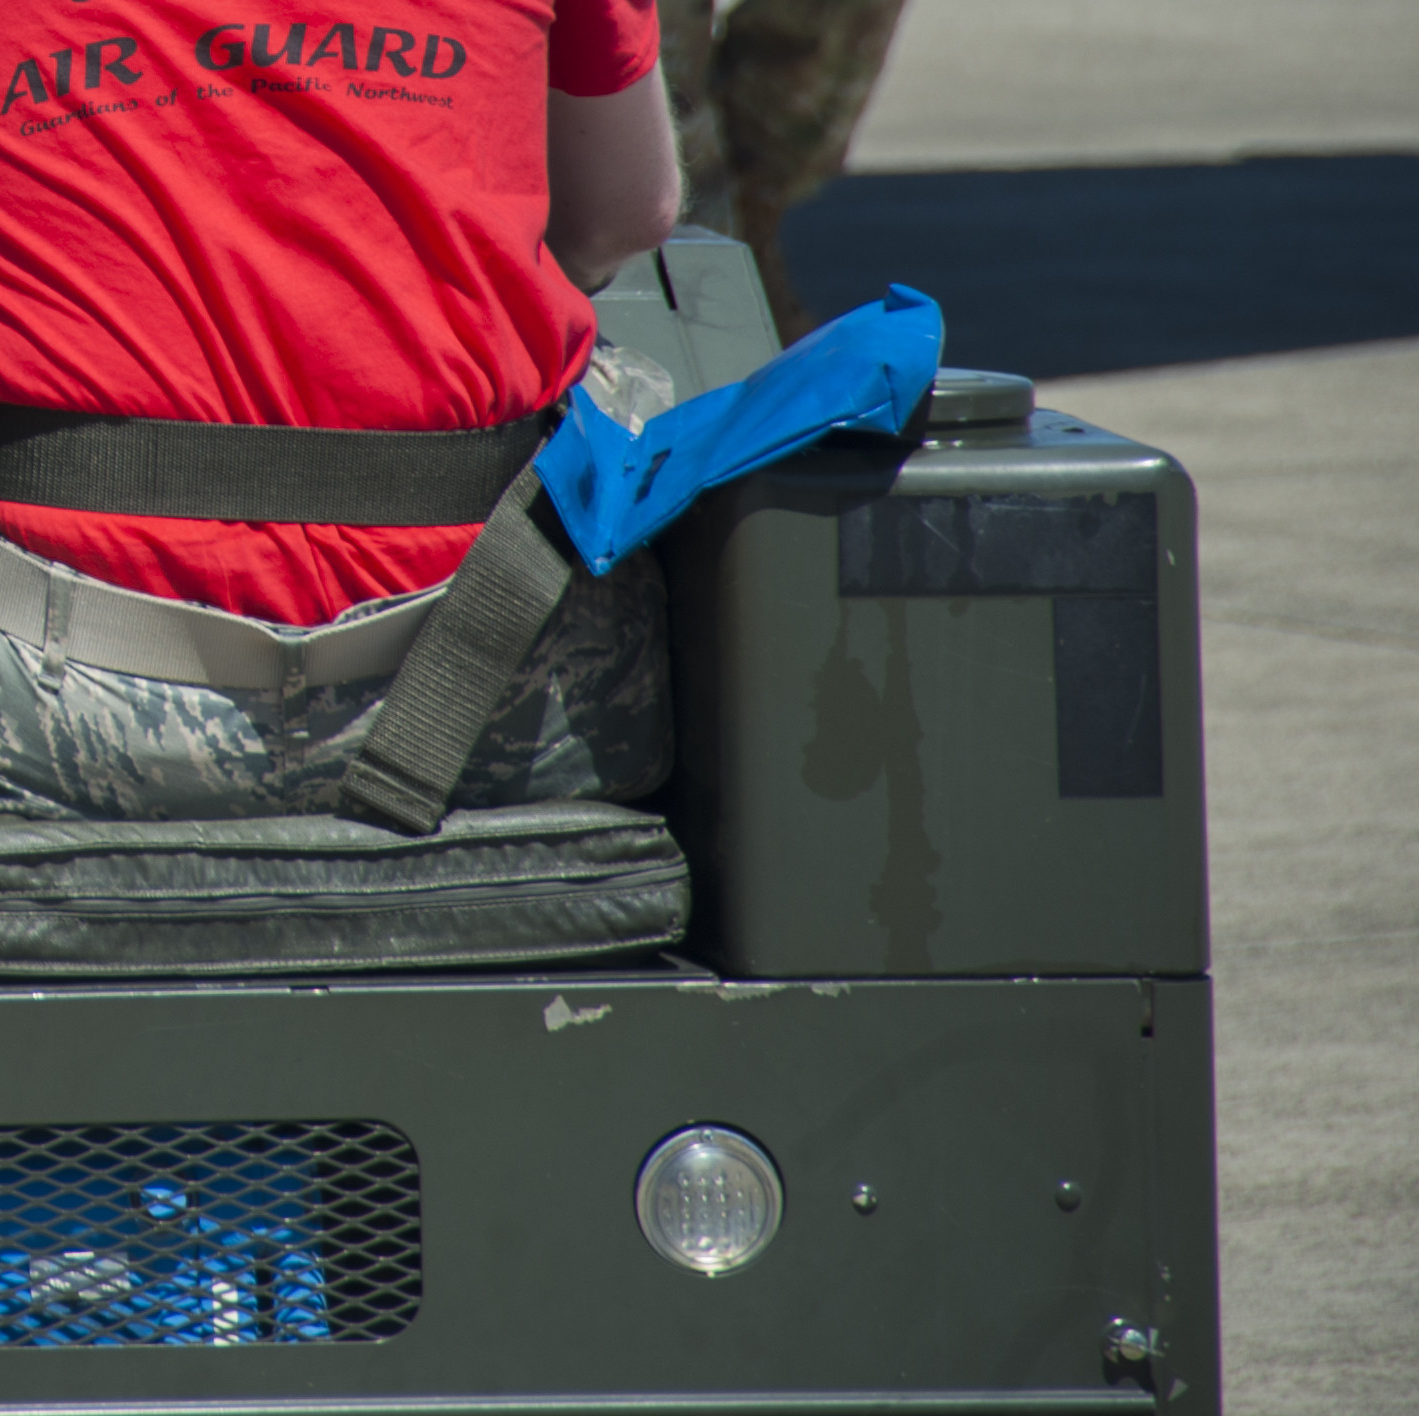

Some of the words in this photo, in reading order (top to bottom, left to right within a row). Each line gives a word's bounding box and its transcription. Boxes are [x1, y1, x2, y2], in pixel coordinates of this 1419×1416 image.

[1, 36, 144, 116] AIR
[194, 22, 467, 81] GUARD
[19, 97, 139, 137] Guardians
[154, 88, 178, 107] of
[196, 82, 235, 101] the
[249, 77, 332, 95] Pacific
[345, 81, 455, 110] Northwest
